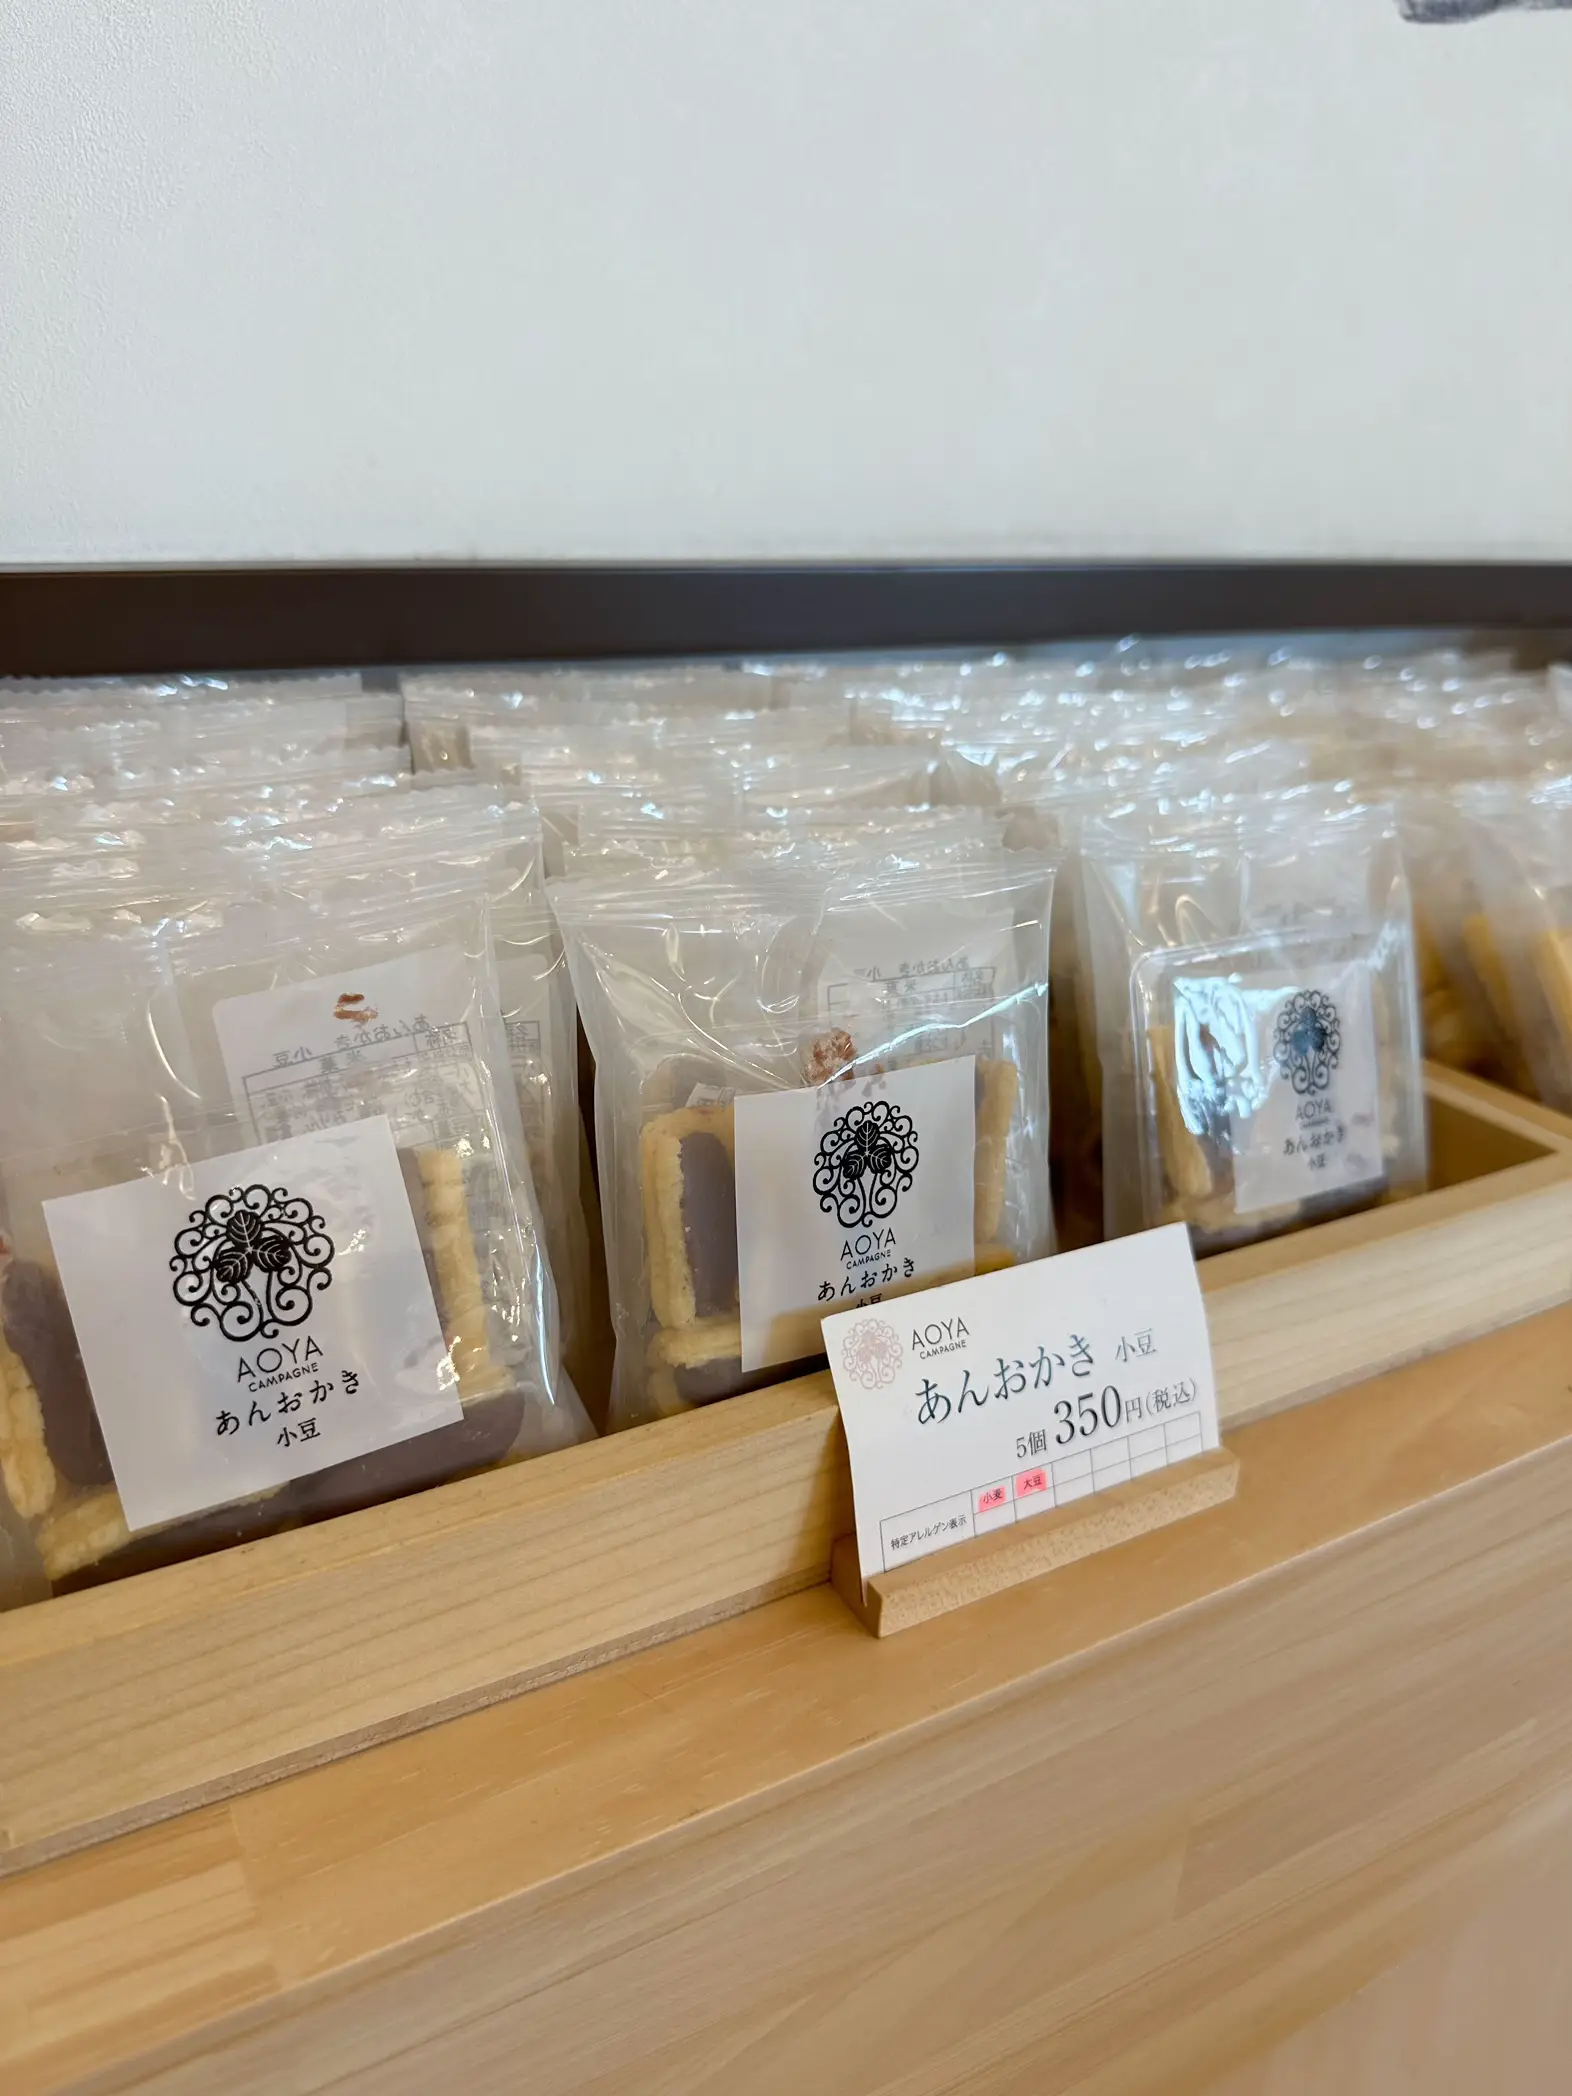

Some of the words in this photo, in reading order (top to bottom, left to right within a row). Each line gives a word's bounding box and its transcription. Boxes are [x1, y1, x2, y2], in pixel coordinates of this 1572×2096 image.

[1295, 1098, 1332, 1121] AOYA
[840, 1227, 896, 1261] AOYA
[846, 1249, 891, 1270] CAMPAGNE
[818, 1257, 914, 1301] あんおかき
[911, 1317, 970, 1351] AOYA
[919, 1339, 967, 1360] CAMPAGNE
[237, 1335, 323, 1383] AOYA
[915, 1334, 1095, 1424] あんおかき
[1115, 1328, 1157, 1363] 小豆
[248, 1362, 318, 1392] CAMPAGNE
[216, 1370, 359, 1436] あんおかき
[277, 1417, 321, 1447] 小豆
[983, 1488, 1003, 1504] 小麦
[1023, 1474, 1043, 1490] 大豆
[890, 1514, 968, 1550] 特定アレルゲン表示
